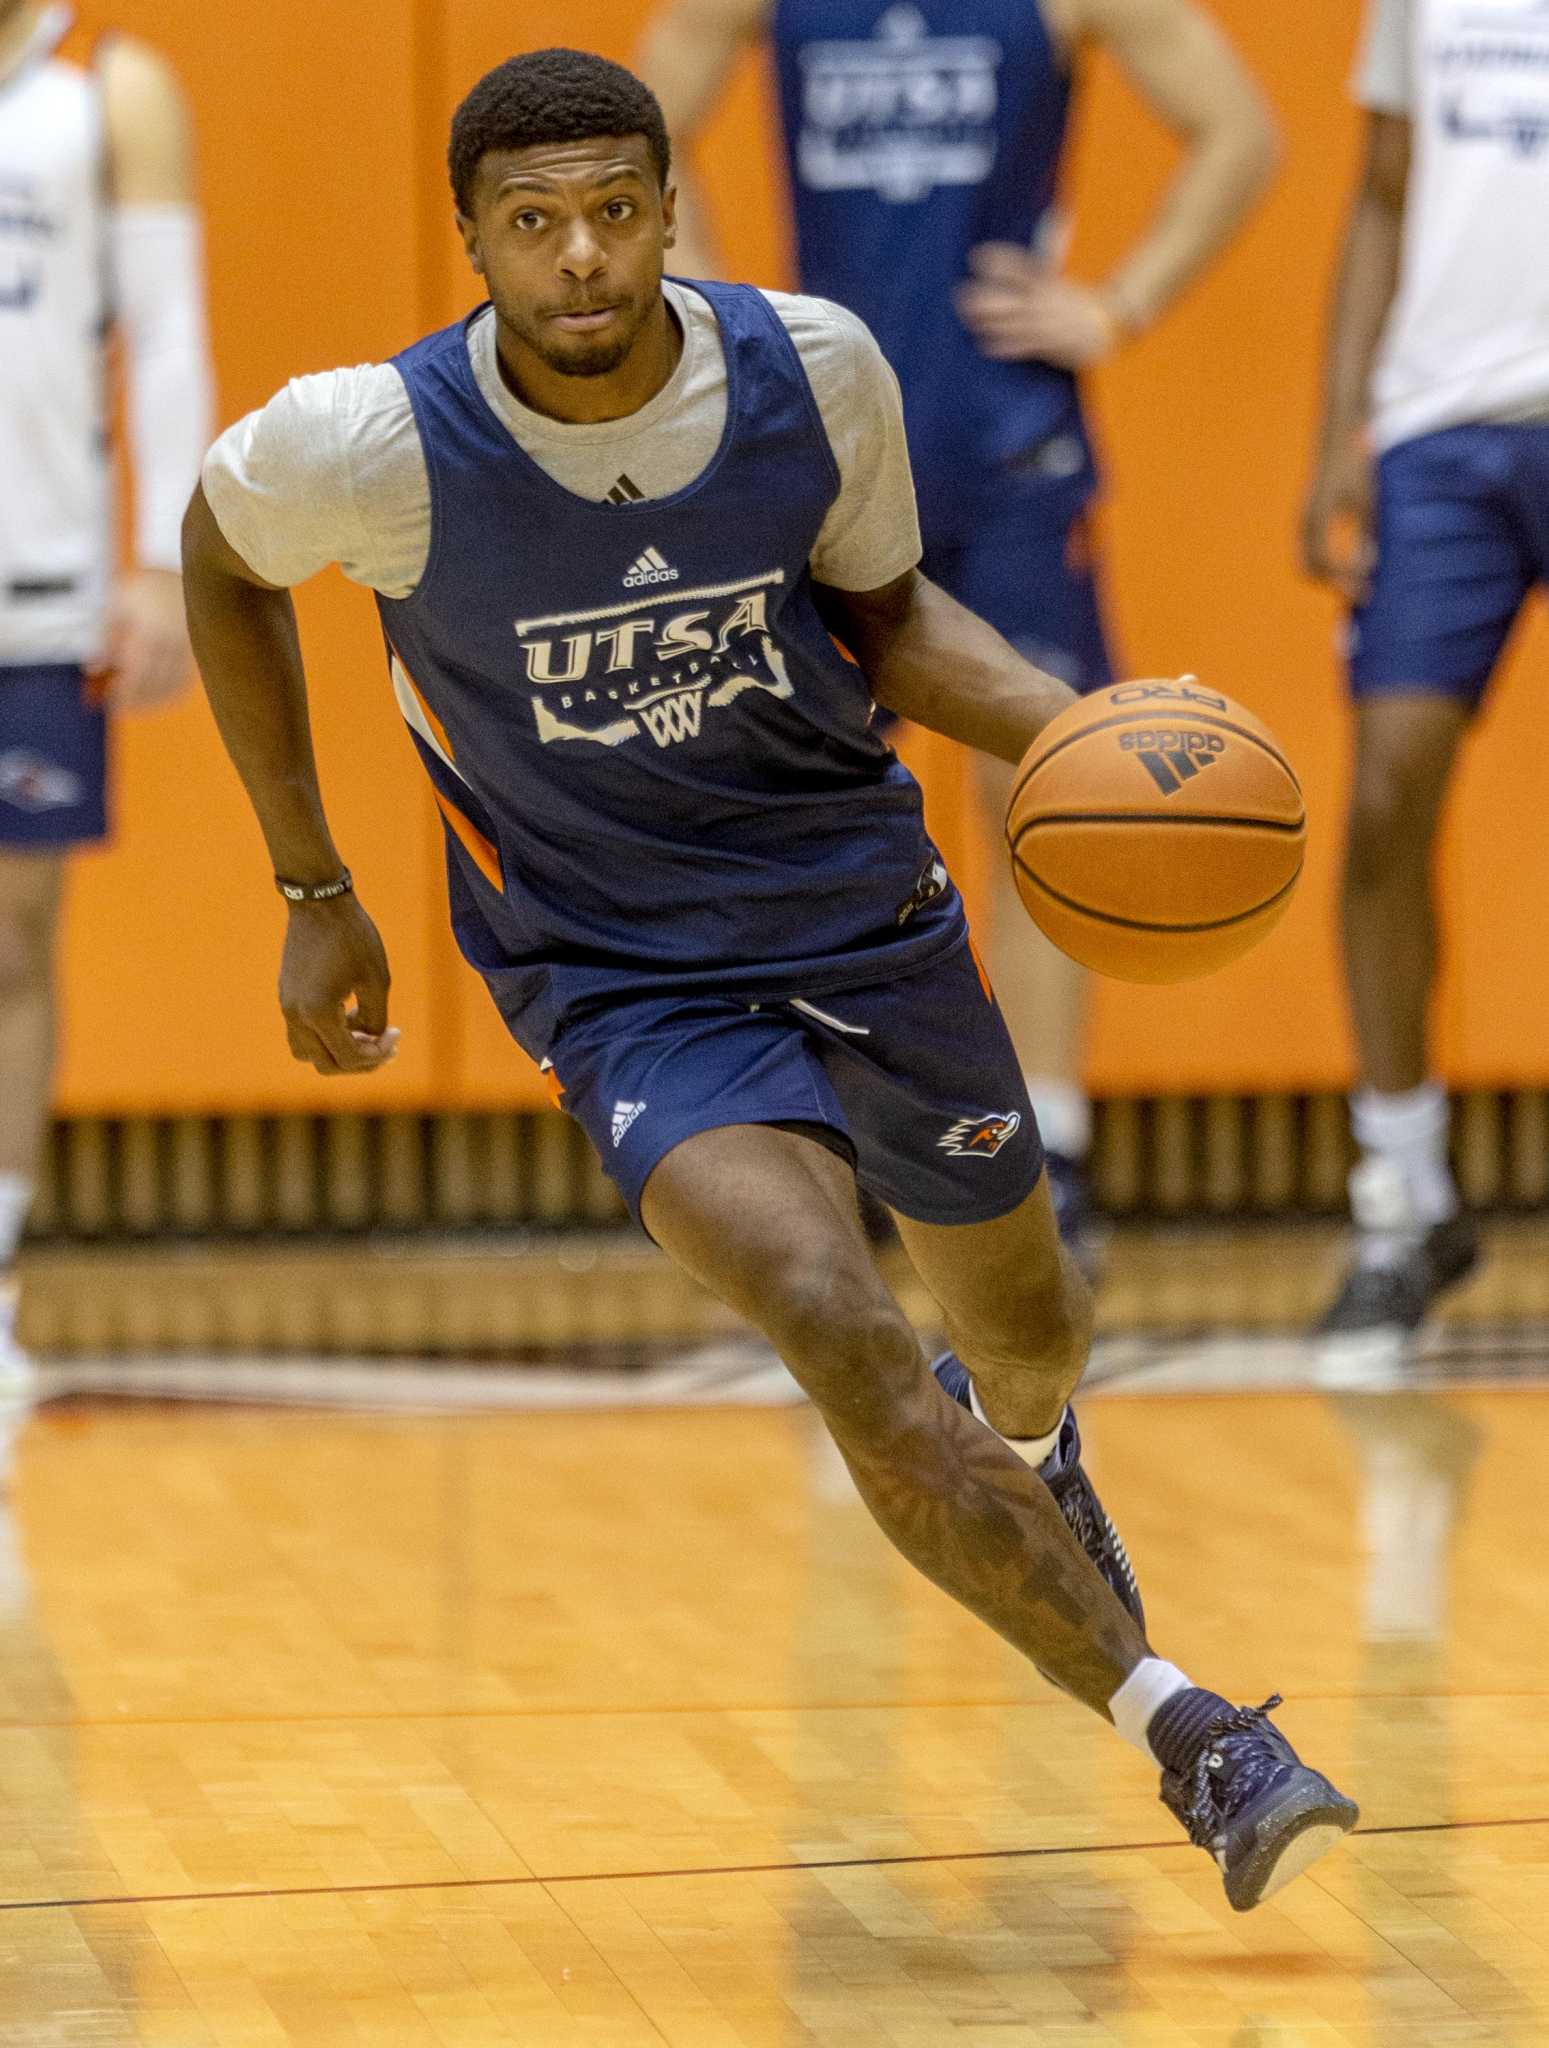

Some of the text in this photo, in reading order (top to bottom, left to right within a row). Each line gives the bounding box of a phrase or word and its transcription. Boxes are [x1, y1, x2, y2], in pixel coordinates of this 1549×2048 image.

[623, 569, 679, 587] adidas
[519, 592, 769, 684] UTSA
[1119, 731, 1225, 752] adidas
[613, 1101, 647, 1148] adidas
